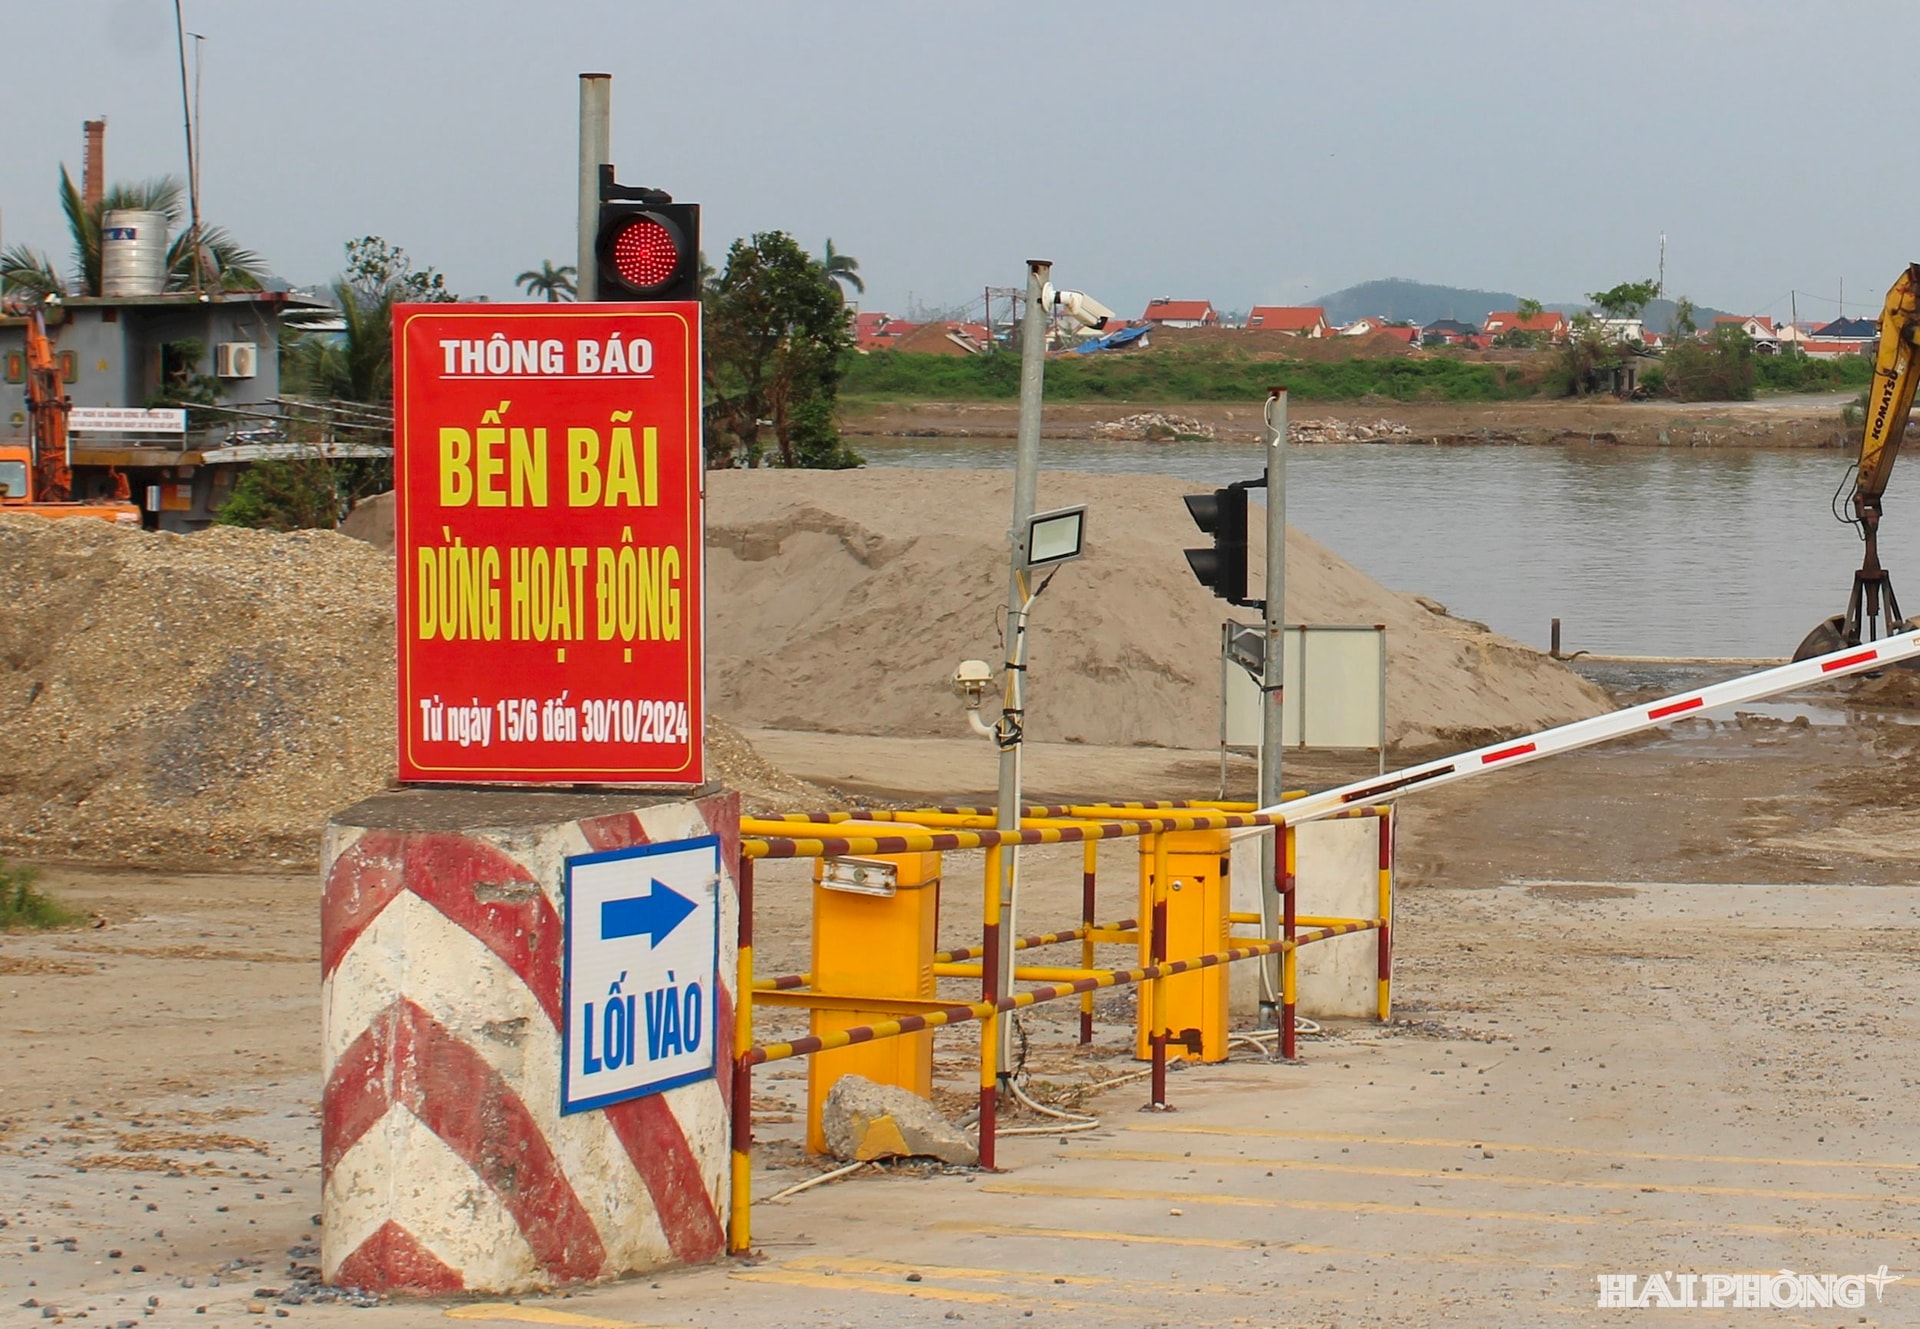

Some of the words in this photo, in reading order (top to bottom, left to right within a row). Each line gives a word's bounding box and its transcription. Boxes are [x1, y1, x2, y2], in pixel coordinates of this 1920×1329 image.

[439, 332, 564, 374] THÔNG
[577, 332, 653, 374] BÁO
[1871, 369, 1898, 439] KOMATSU
[439, 401, 548, 507] BẾN
[567, 410, 658, 507] BÃI
[418, 526, 501, 641] DỪNG
[510, 547, 588, 663] HOẠT
[595, 526, 681, 663] ĐỘNG
[420, 694, 444, 742] Từ
[447, 697, 492, 747] ngày
[496, 698, 538, 743] 15/6
[542, 690, 577, 742] đến
[581, 698, 688, 744] 30/10/2024
[583, 971, 635, 1076] LỐI
[645, 970, 703, 1062] VÀO
